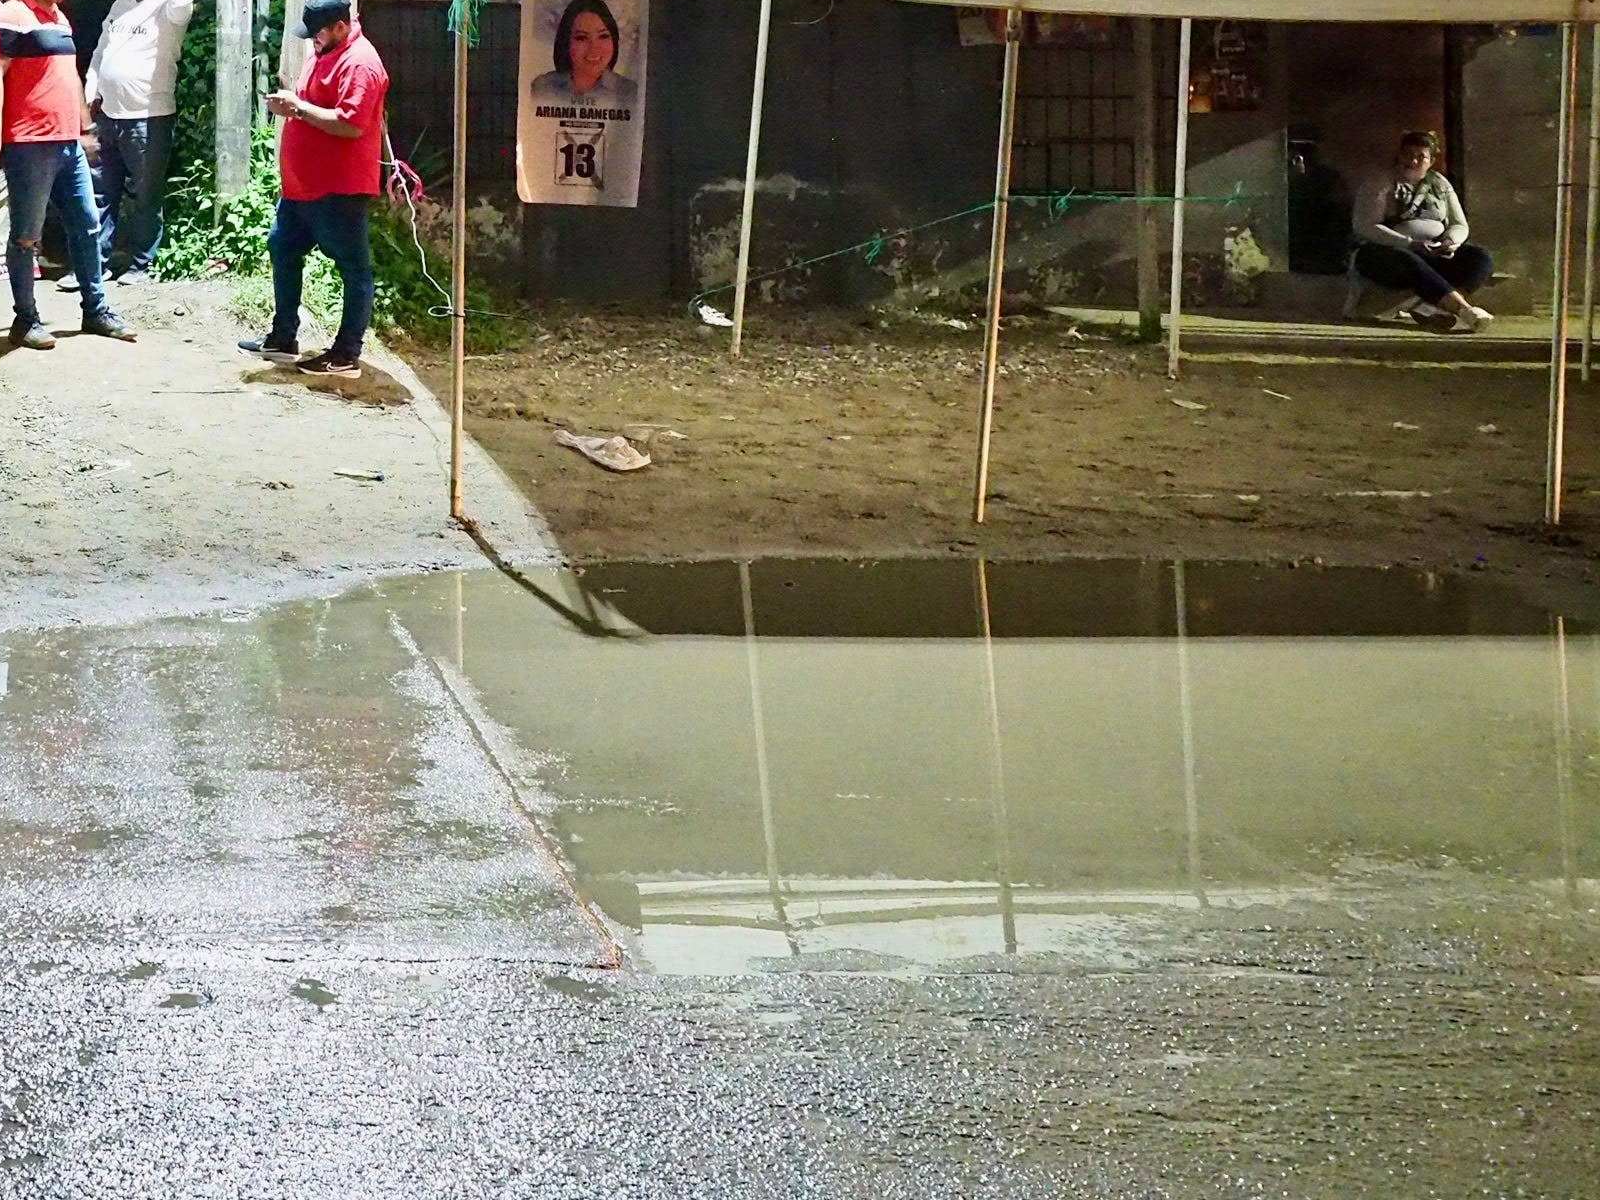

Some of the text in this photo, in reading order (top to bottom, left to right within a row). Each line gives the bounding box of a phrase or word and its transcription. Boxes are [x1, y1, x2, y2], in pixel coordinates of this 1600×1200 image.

[535, 105, 631, 121] ARIANA BANEGAS
[560, 143, 596, 178] 13
